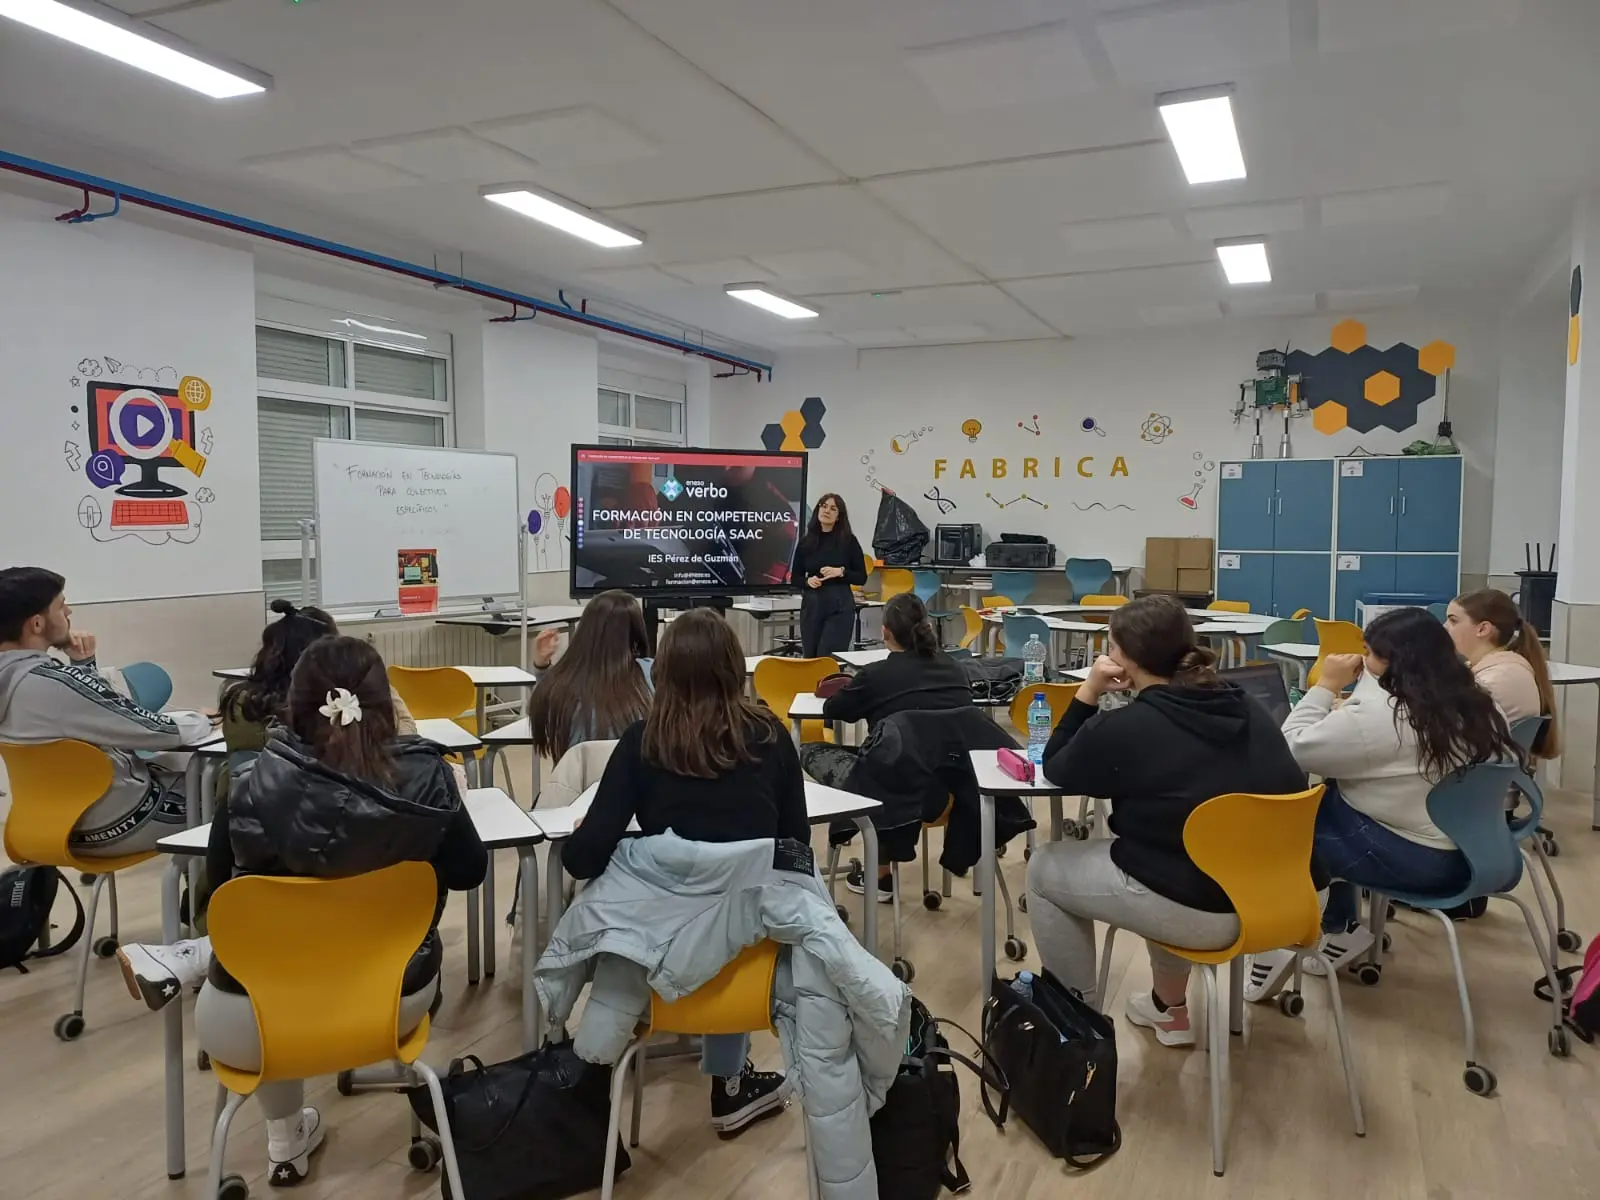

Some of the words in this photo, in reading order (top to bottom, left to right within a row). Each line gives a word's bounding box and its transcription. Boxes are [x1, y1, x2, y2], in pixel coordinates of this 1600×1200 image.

[401, 471, 412, 480] EN
[934, 456, 1129, 480] FABRICA
[376, 484, 396, 497] PARA
[686, 483, 728, 498] verbo
[592, 507, 672, 521] FORMACIÓN
[676, 511, 693, 521] EN
[696, 511, 791, 522] COMPETENCIAS
[623, 529, 641, 539] DE
[644, 526, 725, 539] TECNOLOGÍA
[729, 529, 763, 539] SAAC
[648, 554, 663, 563] IES
[665, 553, 690, 563] Pérez
[690, 554, 703, 563] de
[704, 553, 739, 563] Guzmán
[60, 666, 106, 693] AMENITY
[84, 816, 137, 843] AMENITY
